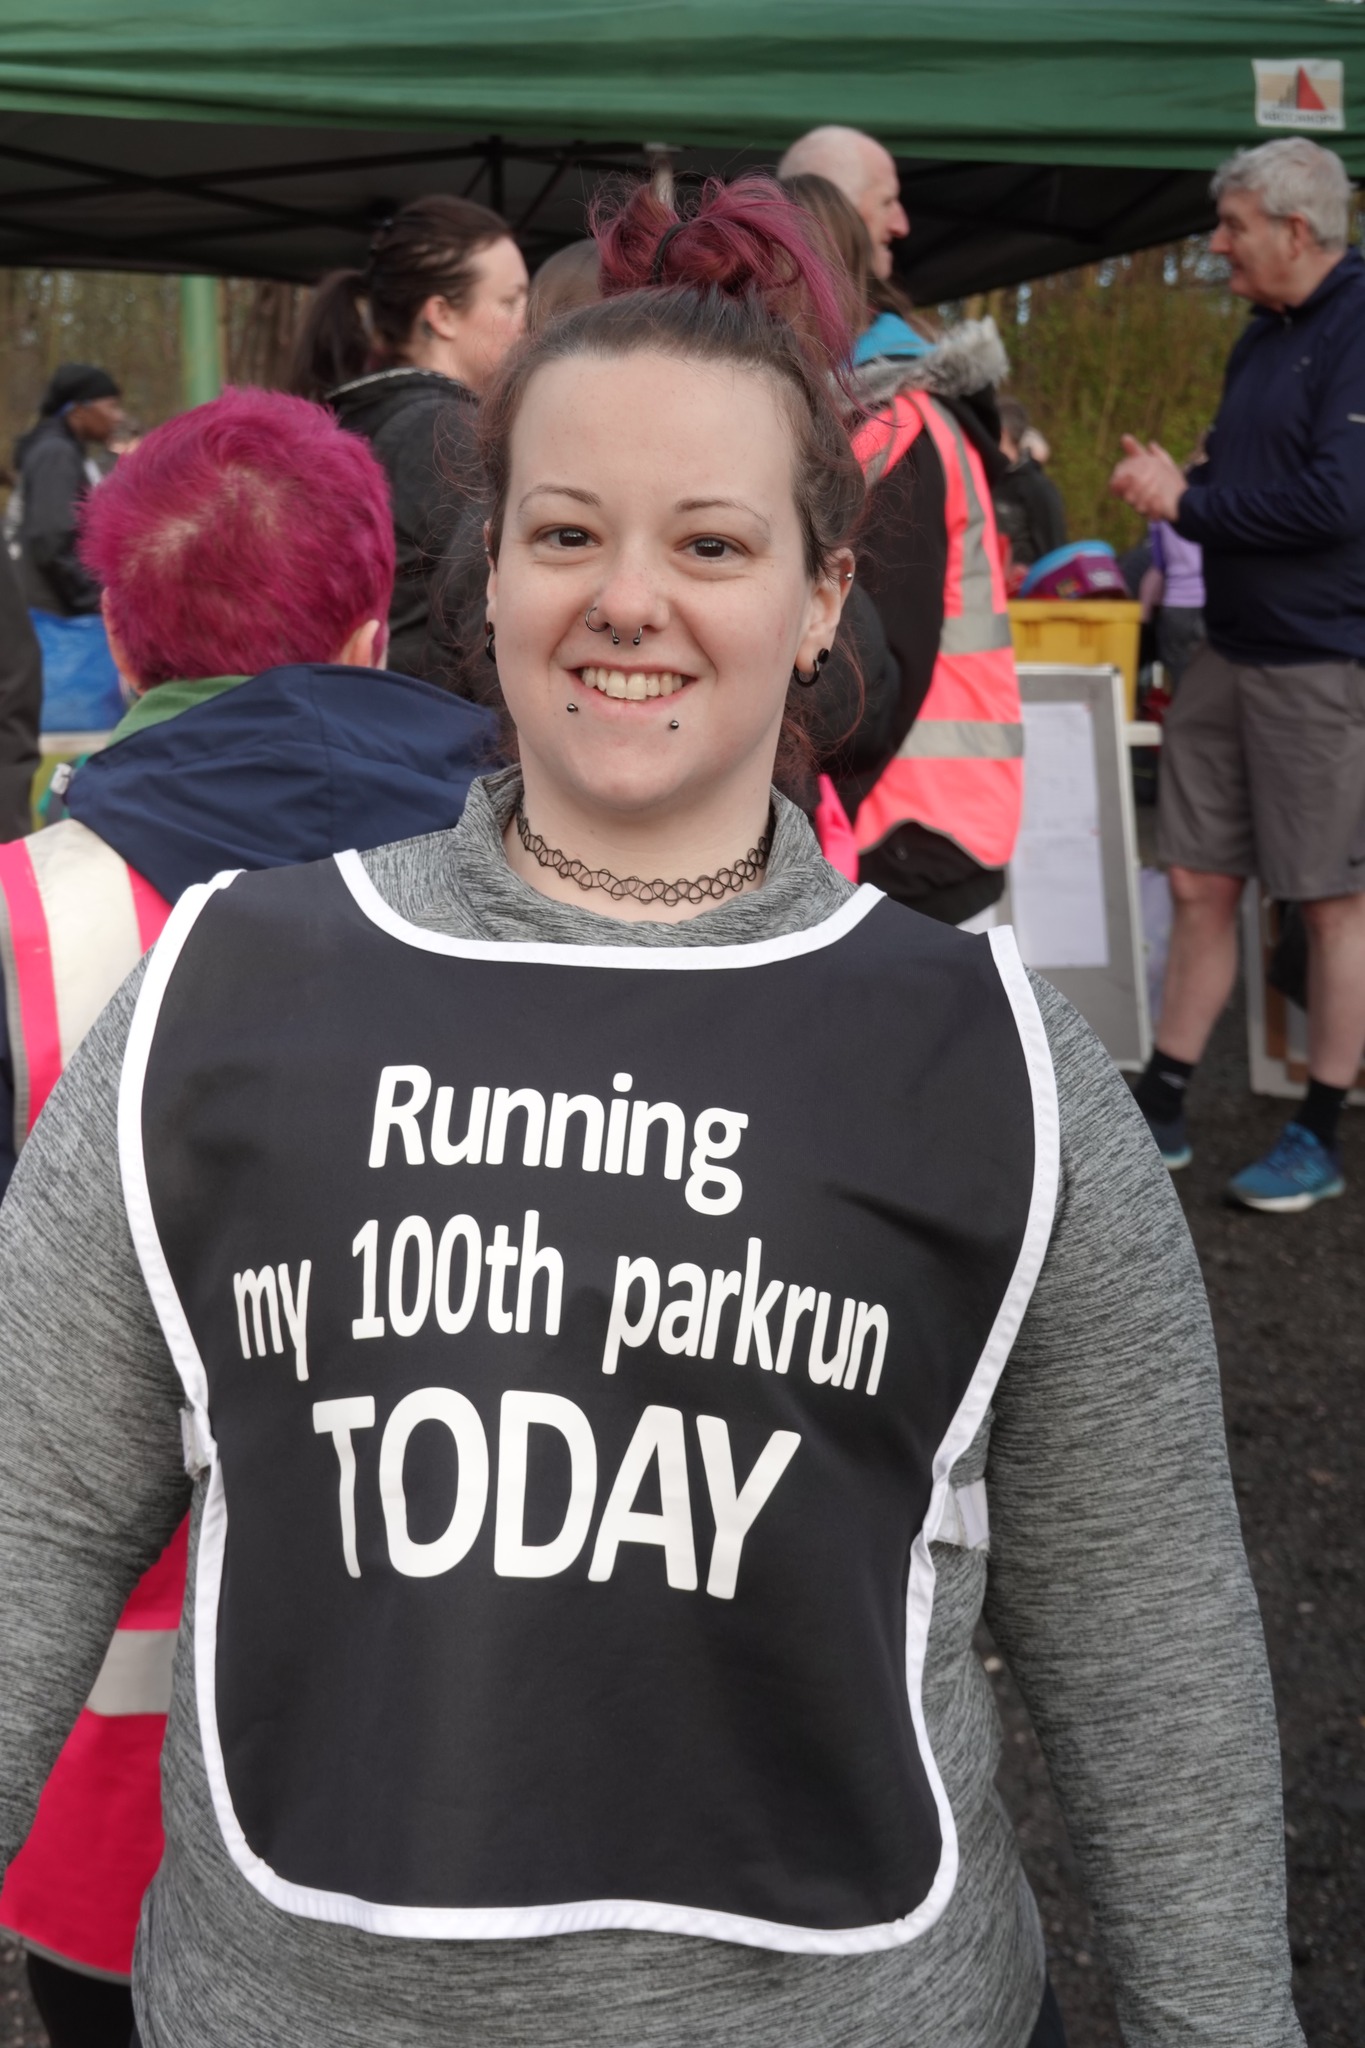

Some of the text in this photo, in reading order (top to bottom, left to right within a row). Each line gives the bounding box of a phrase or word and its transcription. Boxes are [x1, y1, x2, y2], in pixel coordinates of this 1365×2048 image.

[369, 1065, 748, 1215] Running
[233, 1210, 888, 1395] my 100th parkrun
[313, 1387, 801, 1599] TODAY
